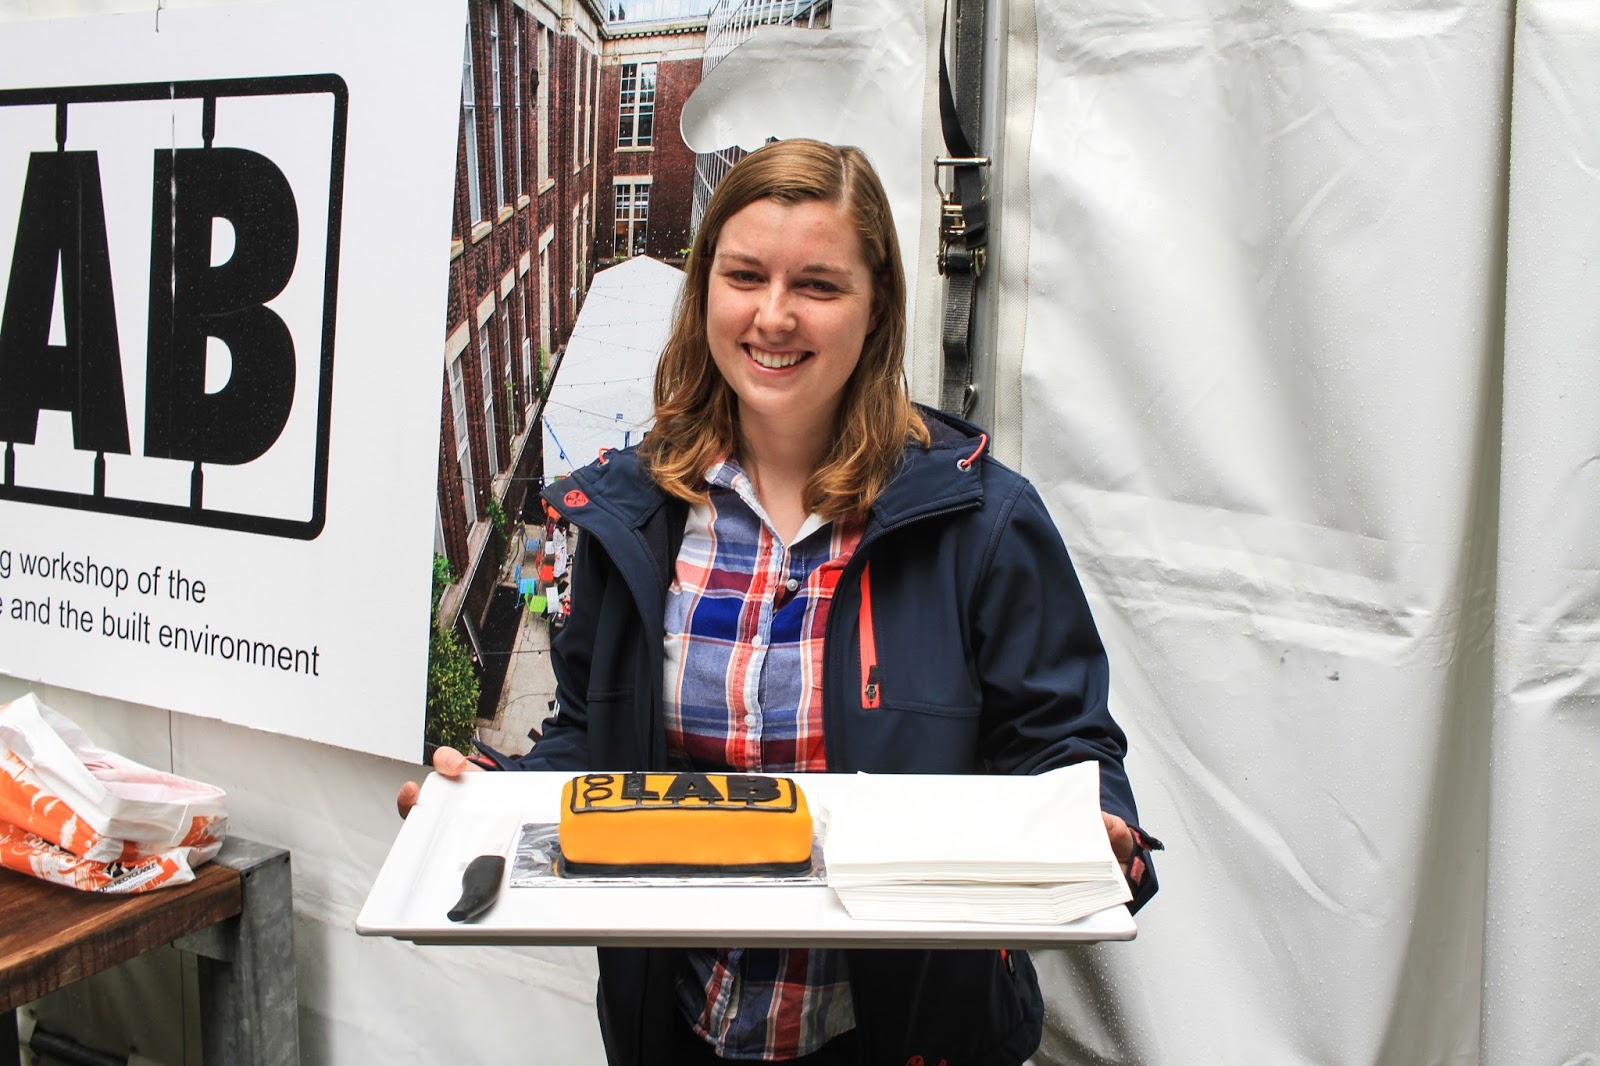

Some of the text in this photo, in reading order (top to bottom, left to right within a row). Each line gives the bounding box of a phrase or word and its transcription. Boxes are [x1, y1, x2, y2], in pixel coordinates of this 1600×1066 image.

[19, 552, 129, 597] workshop
[137, 566, 162, 596] of
[168, 570, 206, 604] the
[10, 597, 51, 625] and
[59, 601, 93, 633] the
[102, 607, 151, 644] built
[158, 625, 320, 677] environment
[621, 773, 782, 801] LAB
[113, 861, 157, 886] RECYCLABLE
